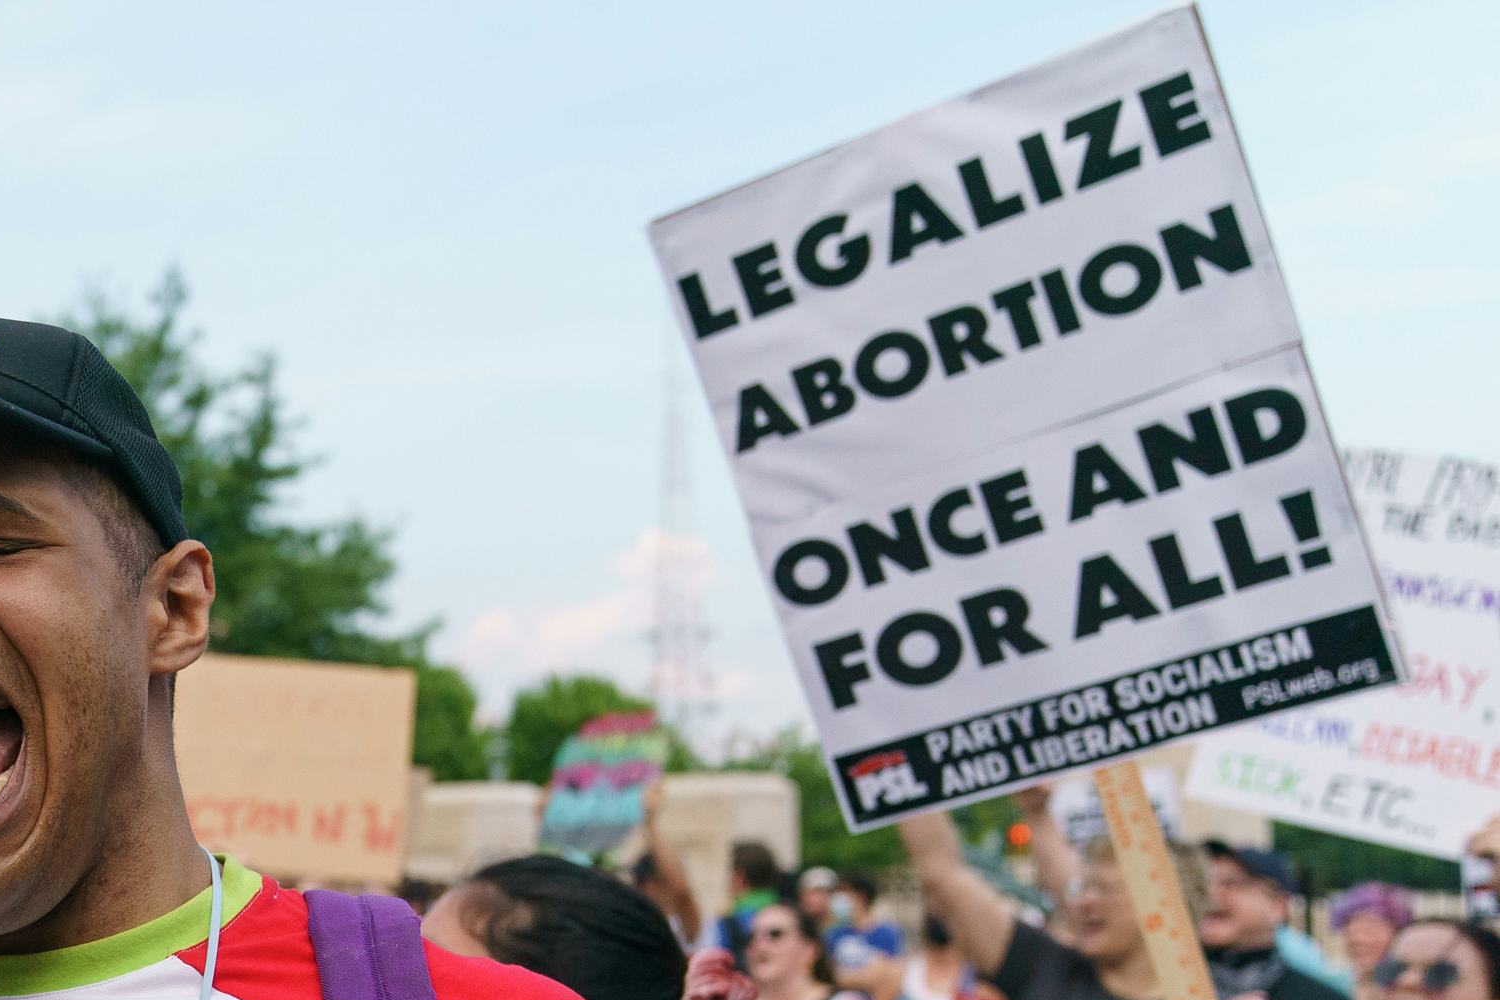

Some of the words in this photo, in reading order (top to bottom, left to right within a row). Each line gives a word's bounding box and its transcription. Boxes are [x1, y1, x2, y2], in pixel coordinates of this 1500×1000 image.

[677, 70, 1212, 341] LEGALIZE
[736, 203, 1253, 455] ABORTION
[774, 469, 1044, 608] ONCE
[1068, 387, 1309, 524] AND
[814, 587, 1048, 710] FOR
[1074, 490, 1333, 640] ALL!
[1241, 656, 1380, 712] PSLweb.org
[925, 706, 1037, 764] PARTY
[1042, 685, 1115, 735] FOR
[1113, 627, 1313, 702] SOCIALISM
[941, 753, 1016, 802] AND
[1012, 697, 1218, 779] LIBERATION
[854, 762, 928, 813] PSL
